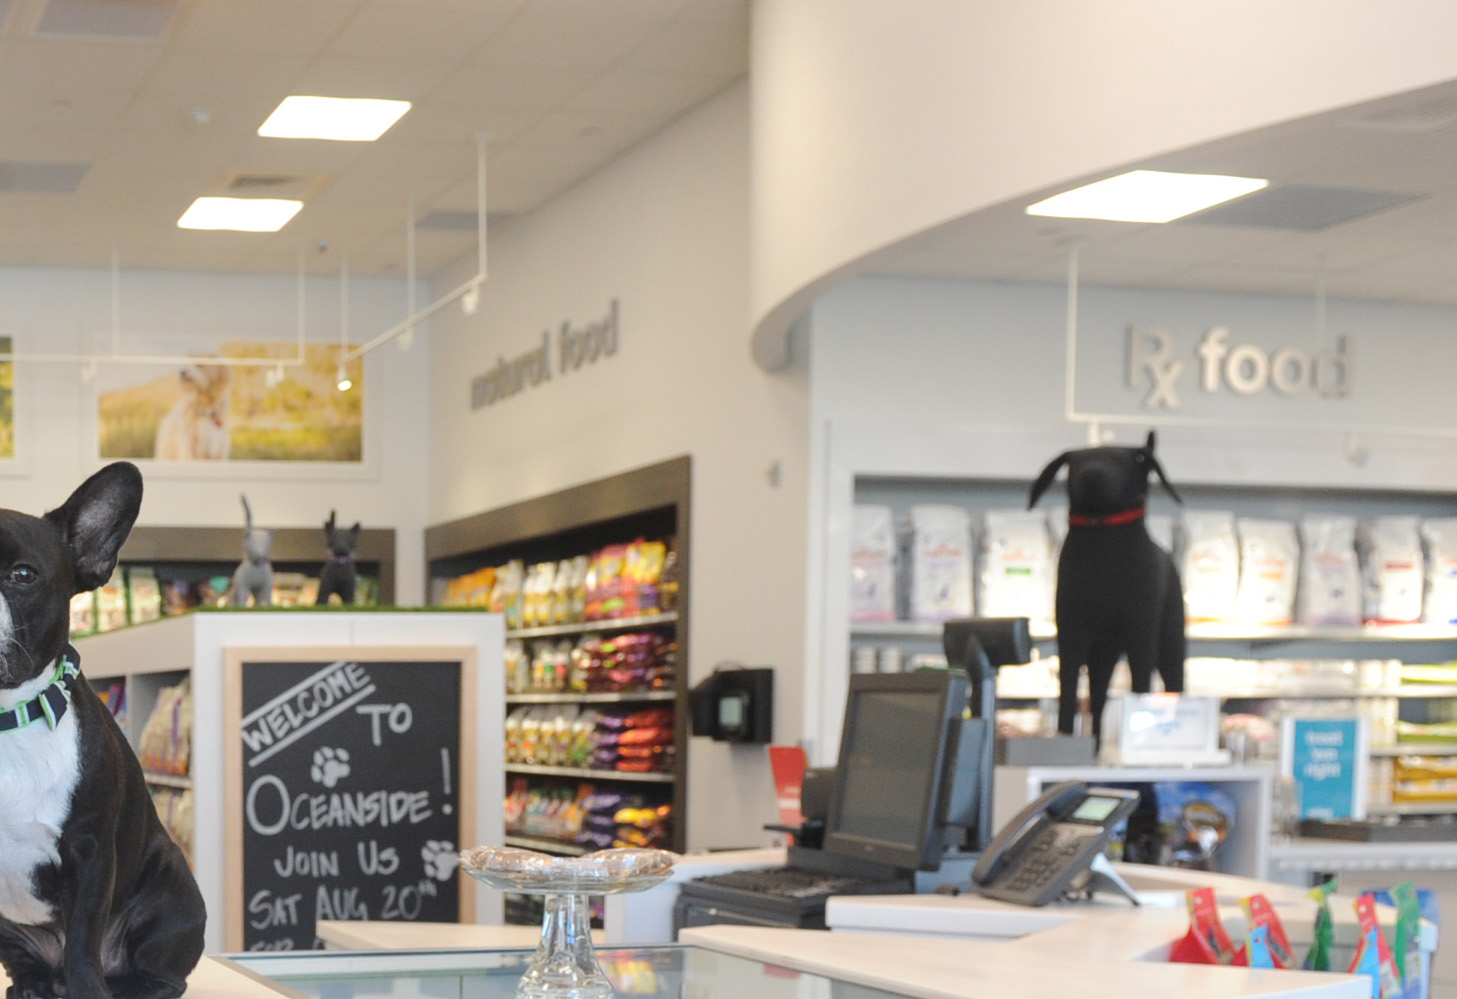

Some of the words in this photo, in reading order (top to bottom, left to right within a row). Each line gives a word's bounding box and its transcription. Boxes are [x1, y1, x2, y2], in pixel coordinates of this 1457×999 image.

[559, 297, 618, 374] food
[1197, 326, 1352, 400] food
[242, 663, 371, 752] WELCOME
[356, 703, 413, 746] TO
[274, 846, 339, 877] JOIN
[358, 840, 399, 875] US
[249, 890, 302, 930] SAT
[316, 884, 368, 922] AUG
